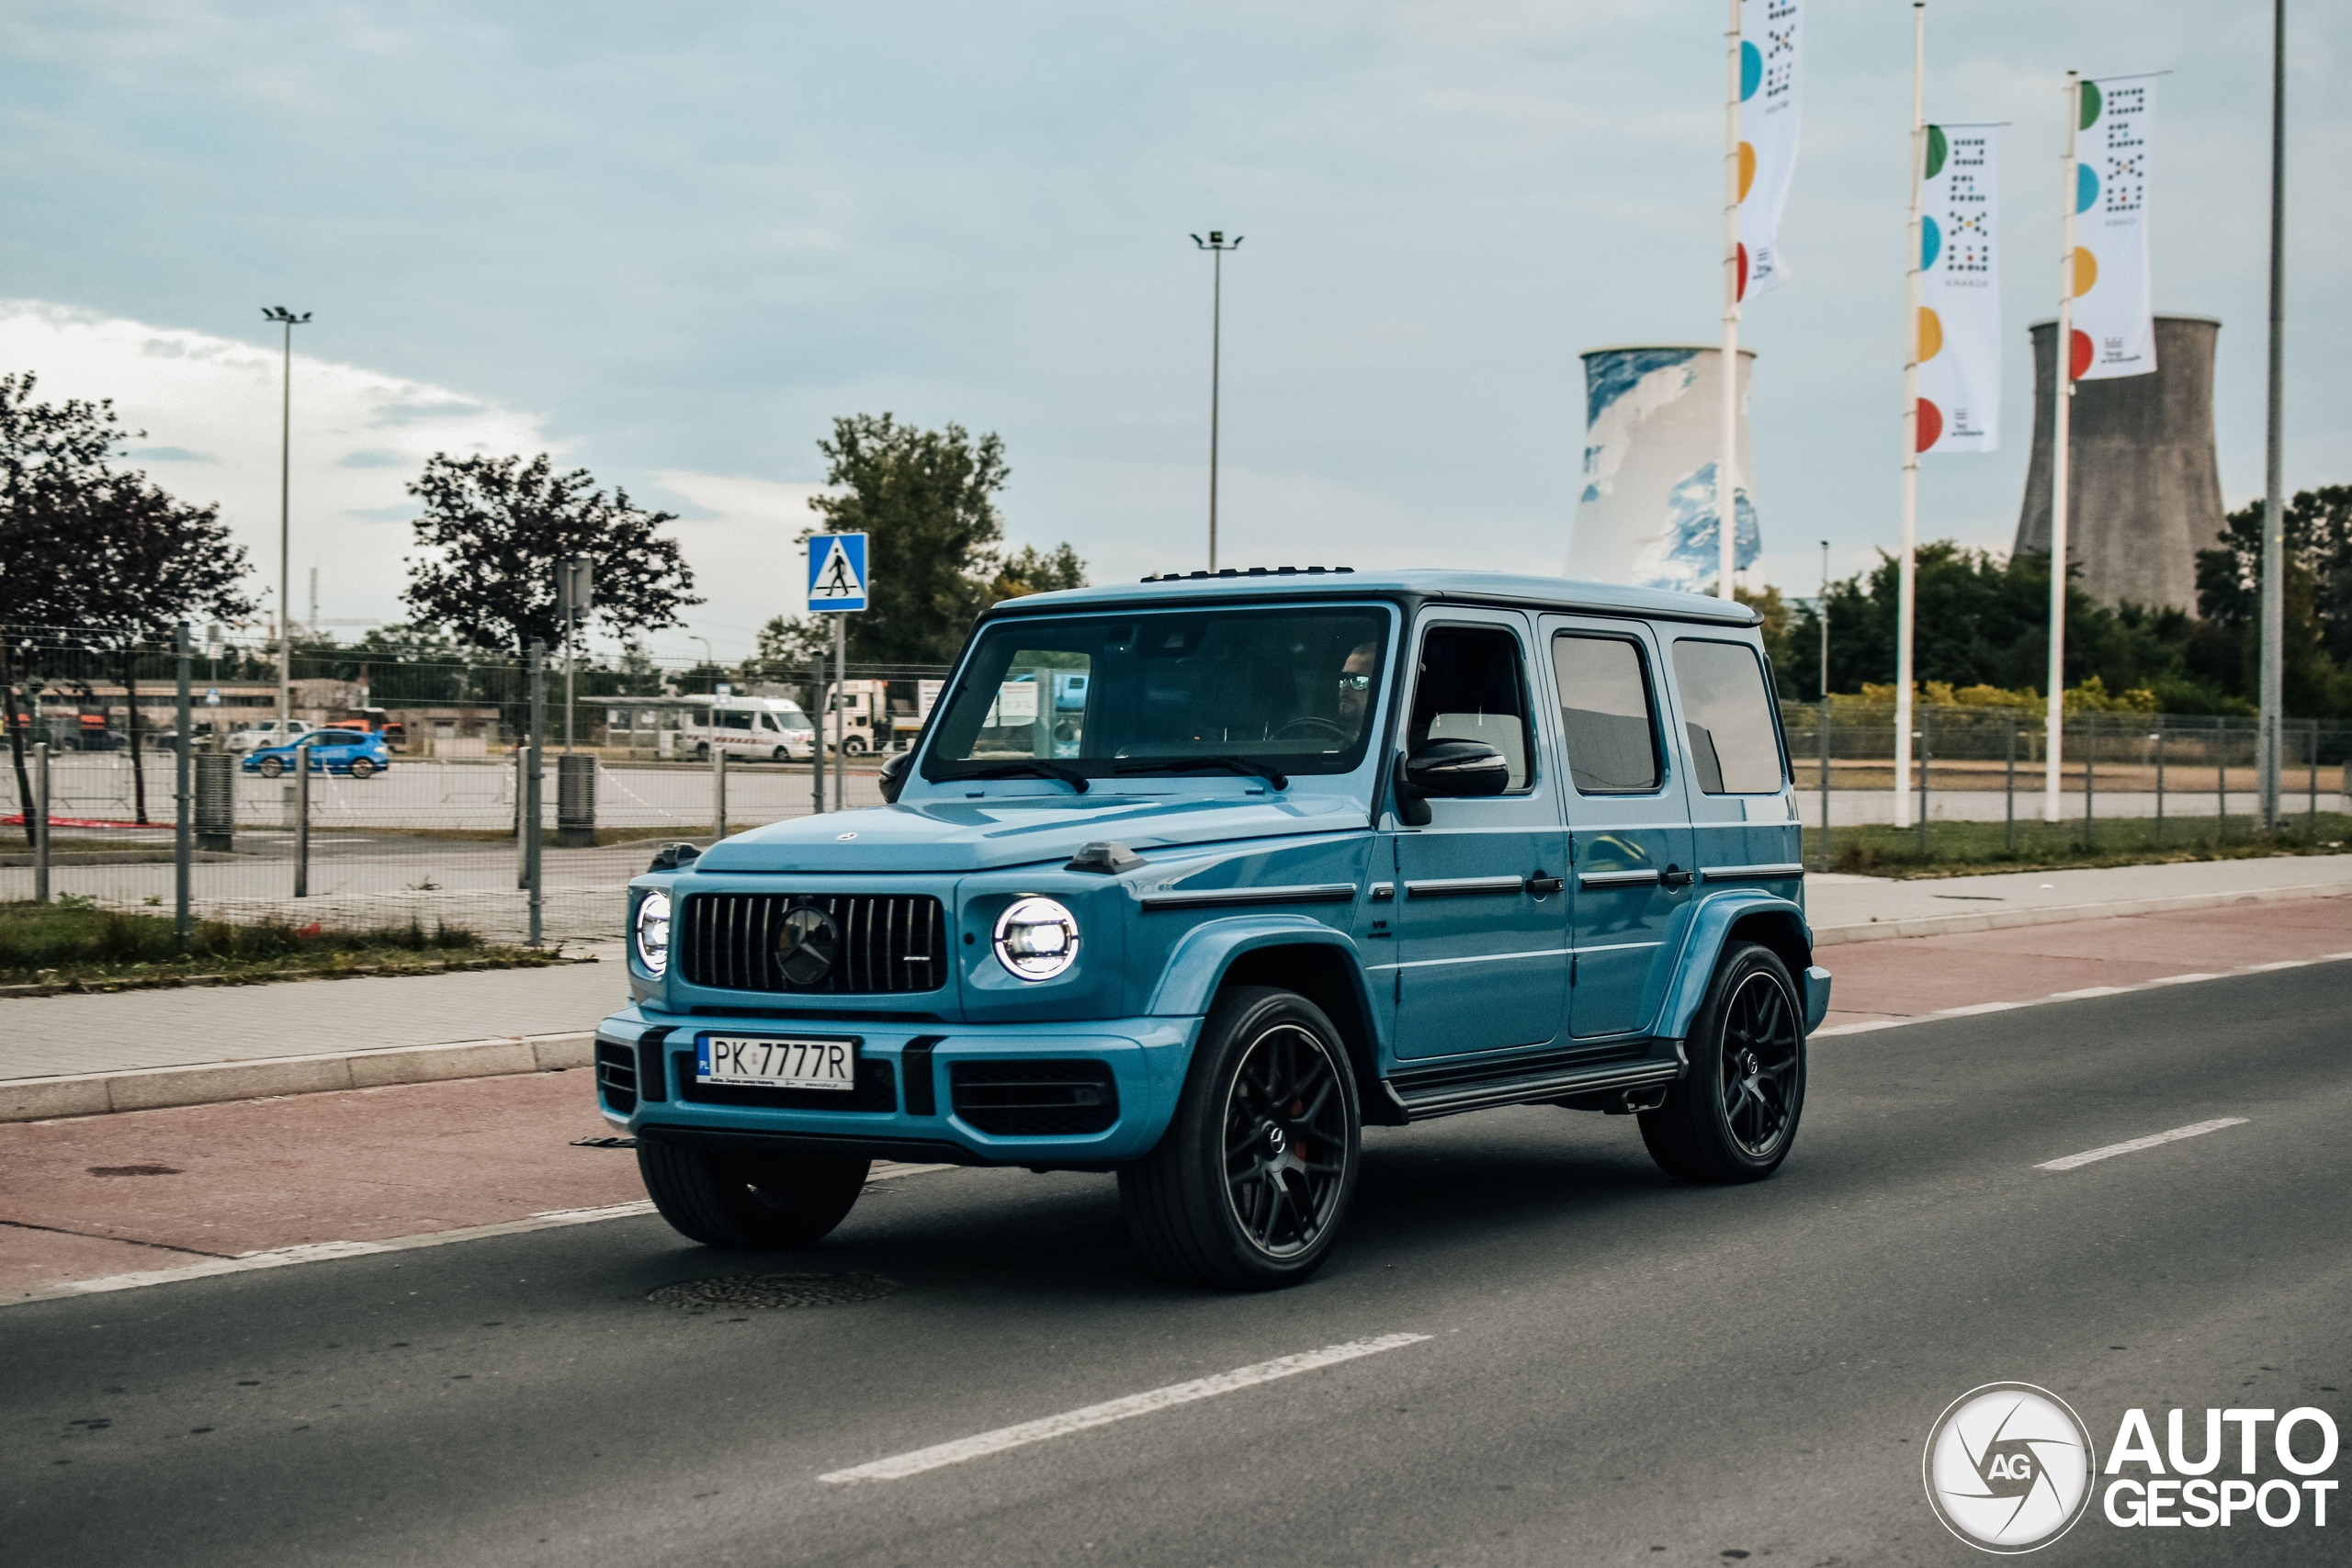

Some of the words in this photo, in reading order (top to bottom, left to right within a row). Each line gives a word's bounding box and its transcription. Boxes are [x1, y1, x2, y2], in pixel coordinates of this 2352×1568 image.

[2105, 88, 2144, 212] EXPO
[1947, 138, 1988, 272] EXPO
[699, 1060, 710, 1070] PL
[715, 1041, 748, 1075] PK
[759, 1043, 846, 1078] 7777R
